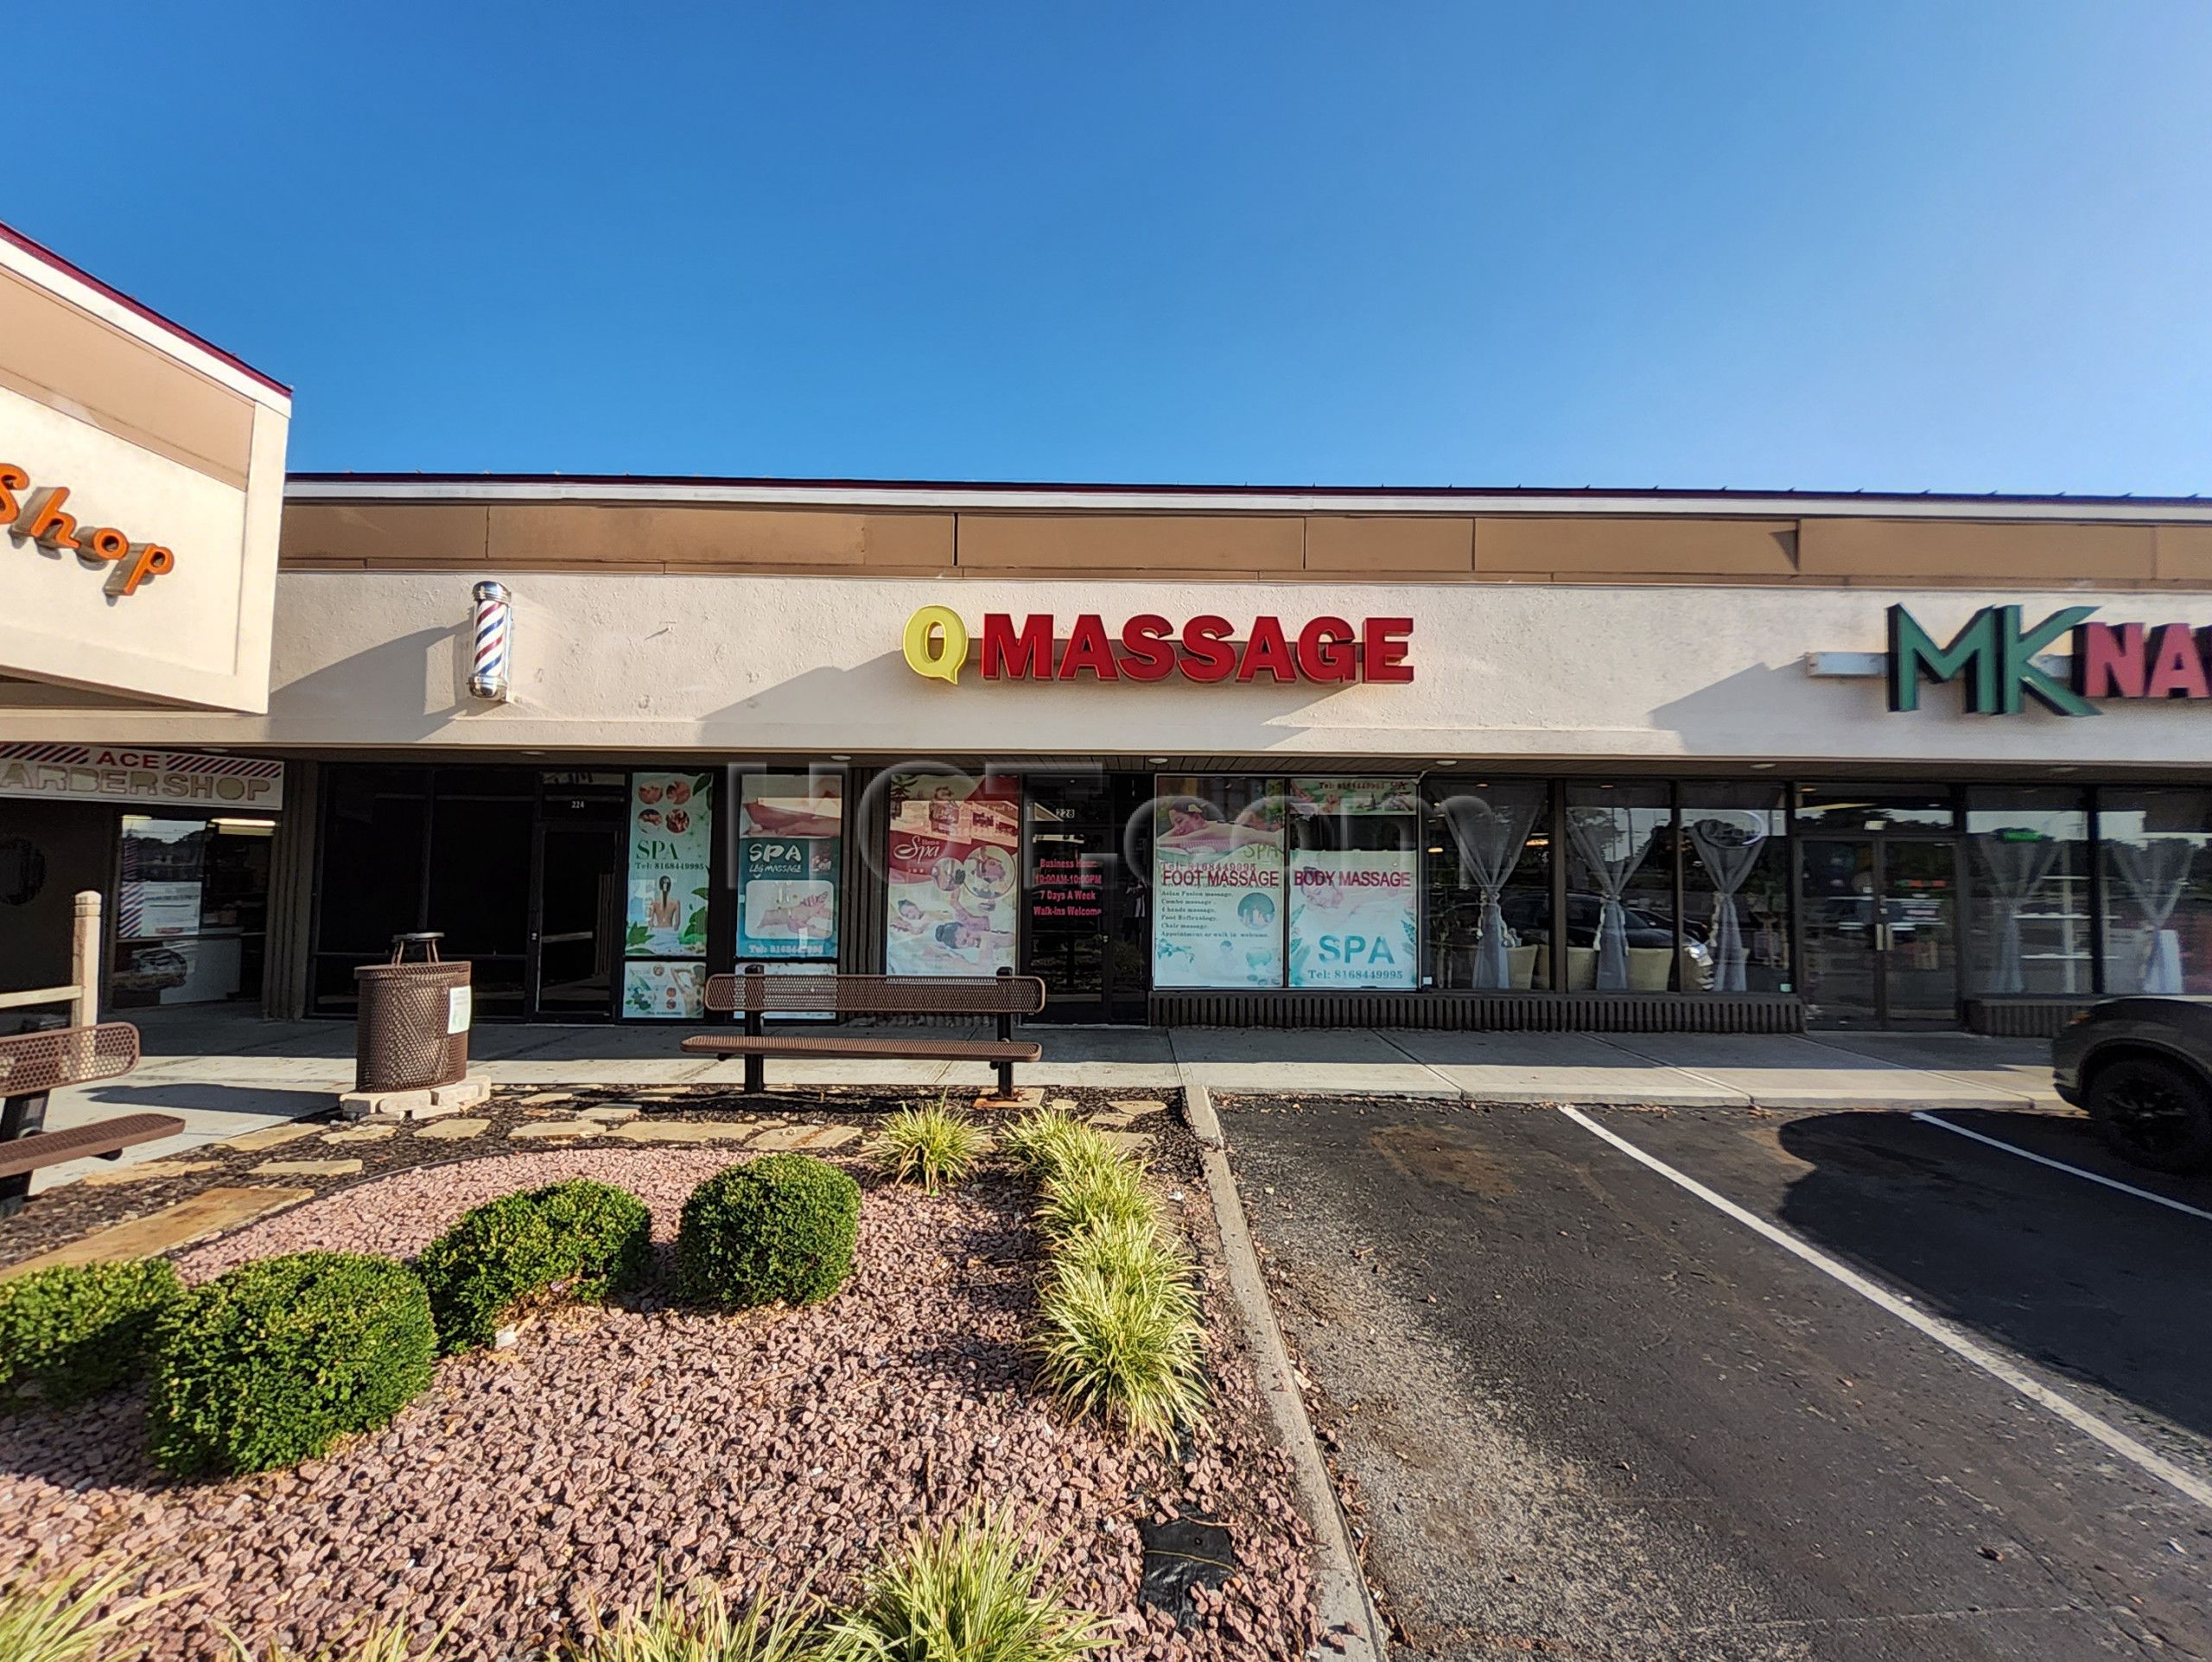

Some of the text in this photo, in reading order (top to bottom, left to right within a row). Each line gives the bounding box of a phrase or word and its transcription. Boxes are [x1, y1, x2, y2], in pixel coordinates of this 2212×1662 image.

[902, 604, 1414, 685] Q MASSAGE
[1887, 602, 2212, 716] MK NA
[97, 751, 161, 769] ACE
[0, 763, 270, 801] ARBERSHOP
[636, 840, 679, 860] SPA
[749, 844, 802, 863] SPA
[893, 836, 940, 864] Spa
[1244, 844, 1279, 860] SPA
[765, 864, 802, 873] MASSAGE
[1040, 858, 1073, 869] Business
[1163, 870, 1204, 886] FOOT
[1207, 870, 1280, 887] MASSAGE
[1294, 870, 1336, 887] BODY
[1338, 870, 1411, 887] MASSAGE
[1039, 890, 1096, 902] 7 Days A Week
[1033, 906, 1102, 915] Walk-ins Welcome
[1319, 934, 1395, 965] SPA
[1308, 970, 1403, 979] Tel: 8168449995
